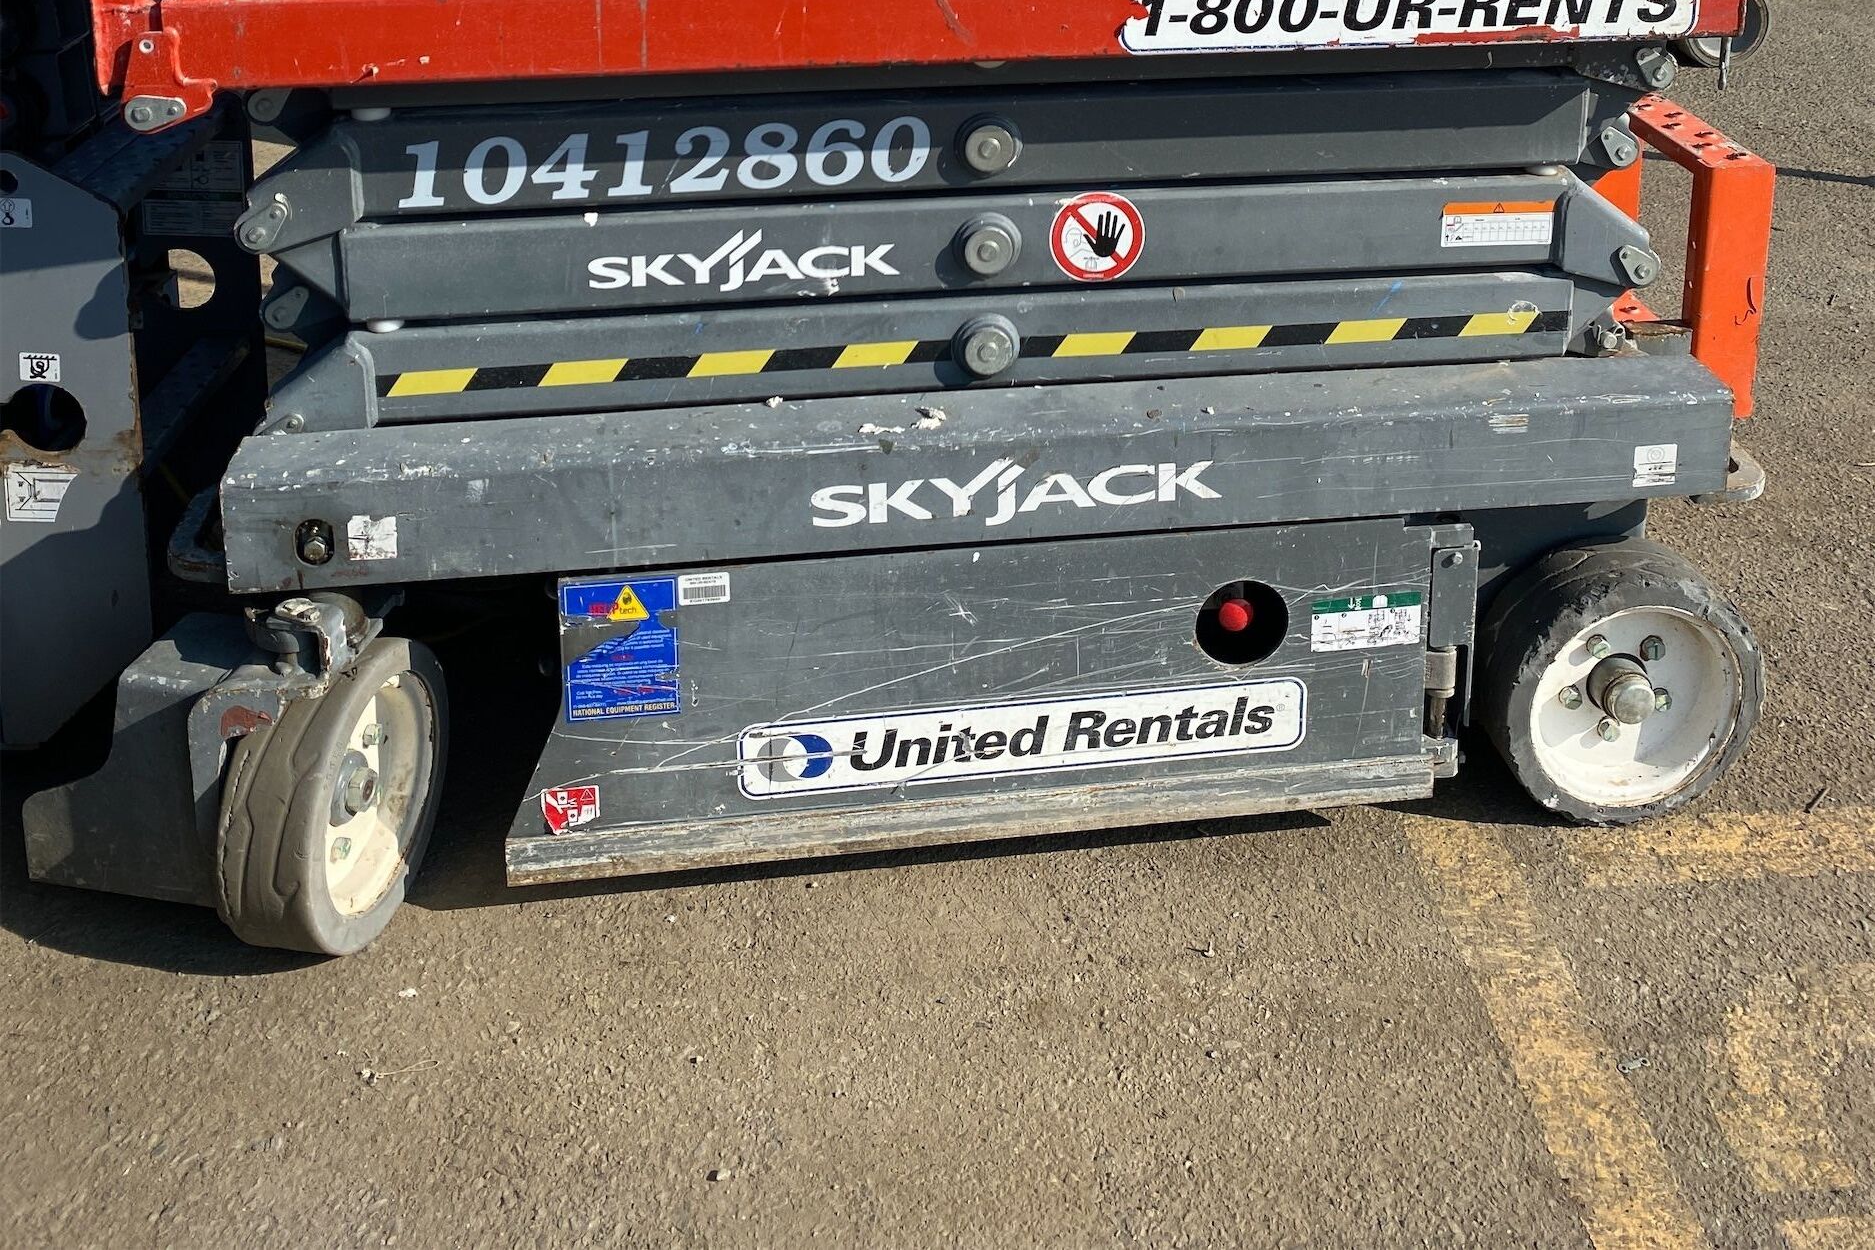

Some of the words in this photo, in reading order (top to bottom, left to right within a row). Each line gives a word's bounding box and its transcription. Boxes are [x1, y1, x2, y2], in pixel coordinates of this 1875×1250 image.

[398, 116, 932, 209] 10412860
[587, 228, 900, 292] SKYJACK
[810, 456, 1223, 527] SKYJACK
[573, 707, 604, 717] NATIONAL
[606, 705, 643, 714] EQUIPMENT
[644, 702, 676, 711] REGISTER
[849, 716, 1047, 771] United
